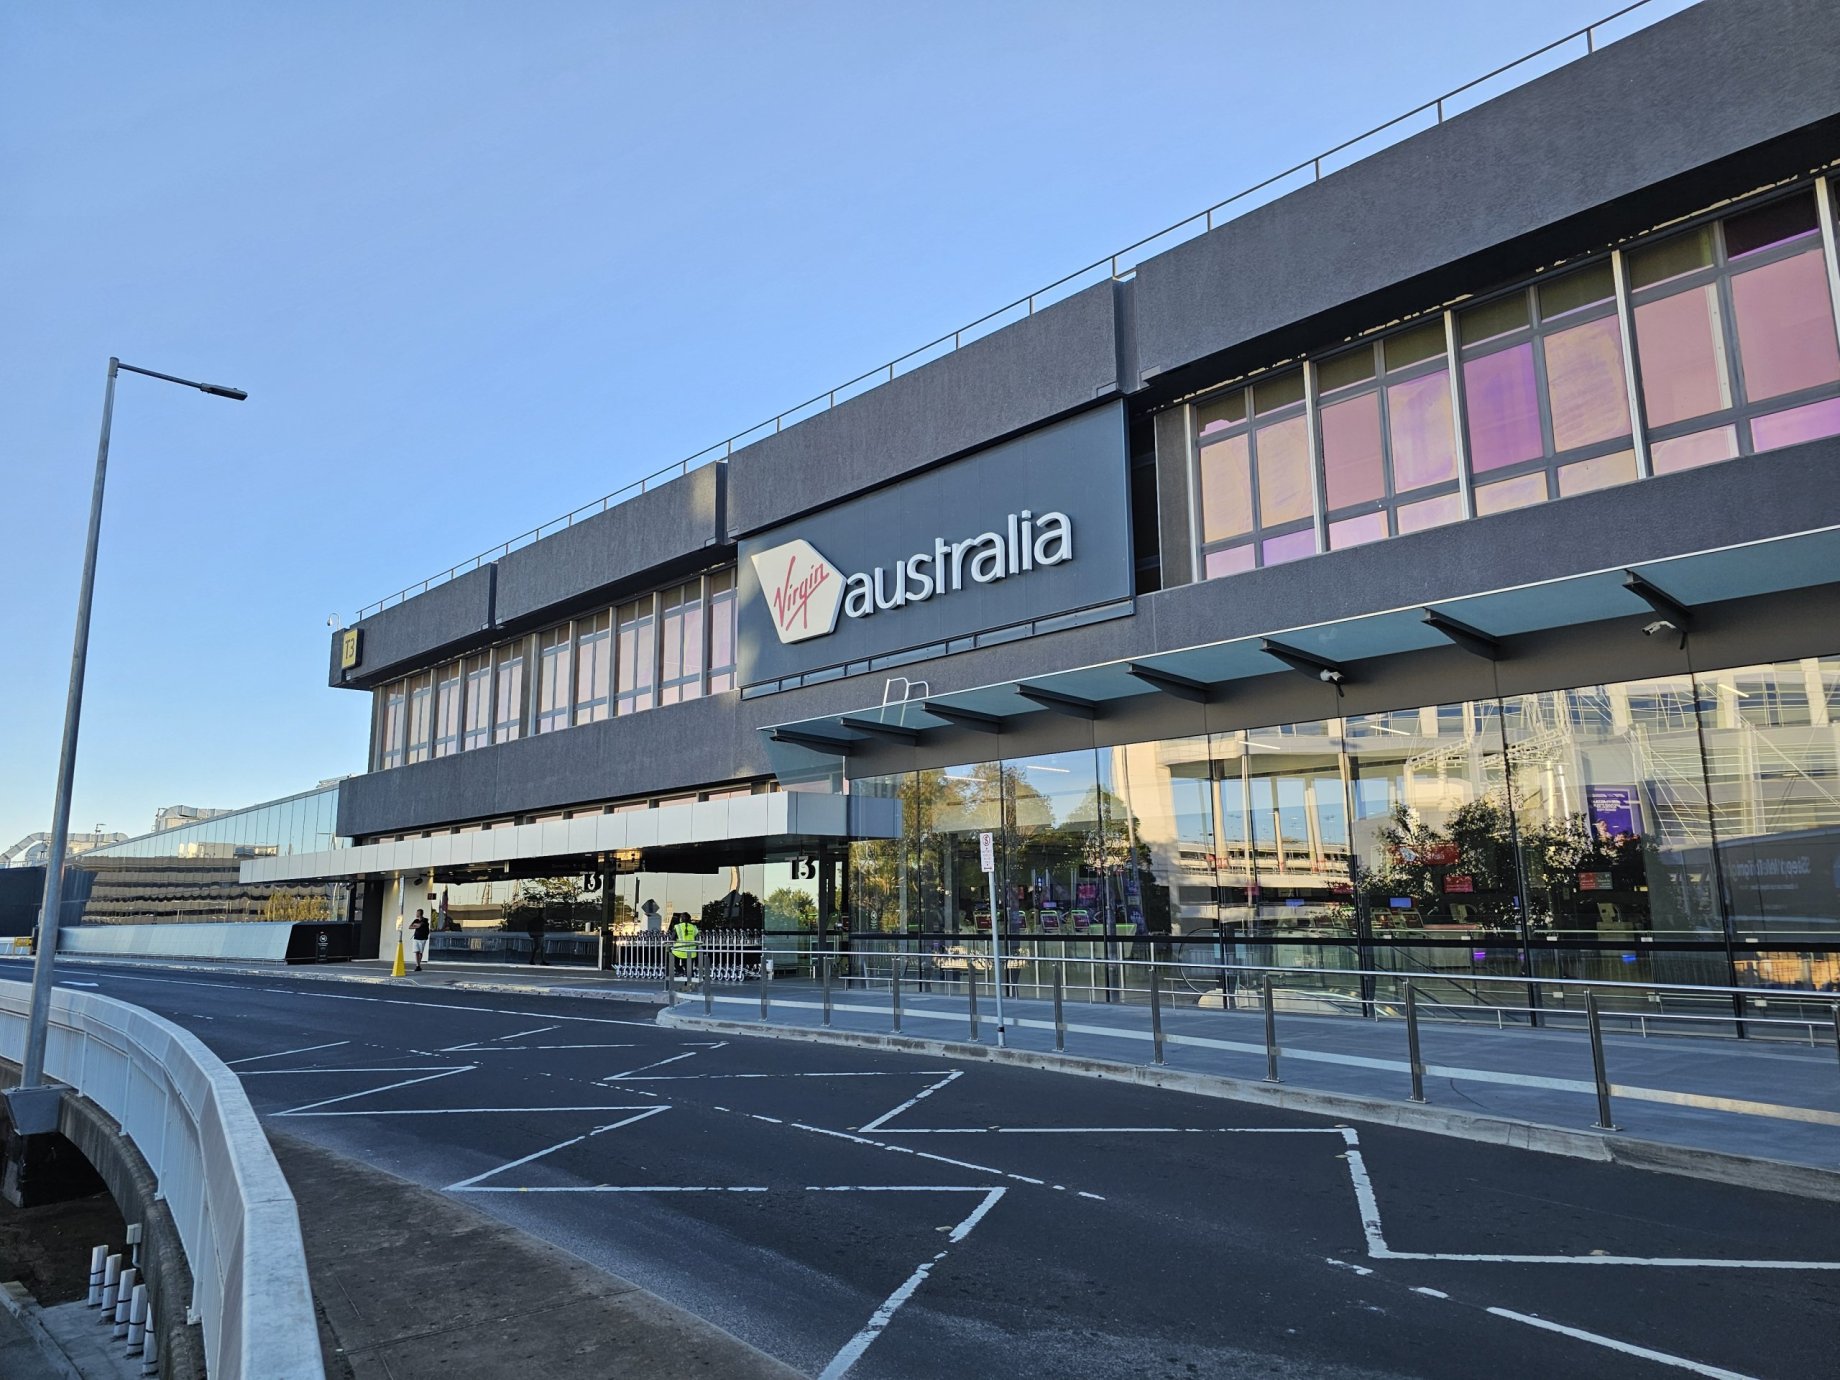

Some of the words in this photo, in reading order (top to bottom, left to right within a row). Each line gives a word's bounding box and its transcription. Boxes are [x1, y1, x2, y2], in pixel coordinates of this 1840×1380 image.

[773, 555, 829, 631] Virgin
[844, 510, 1073, 618] australia
[345, 638, 355, 660] T3
